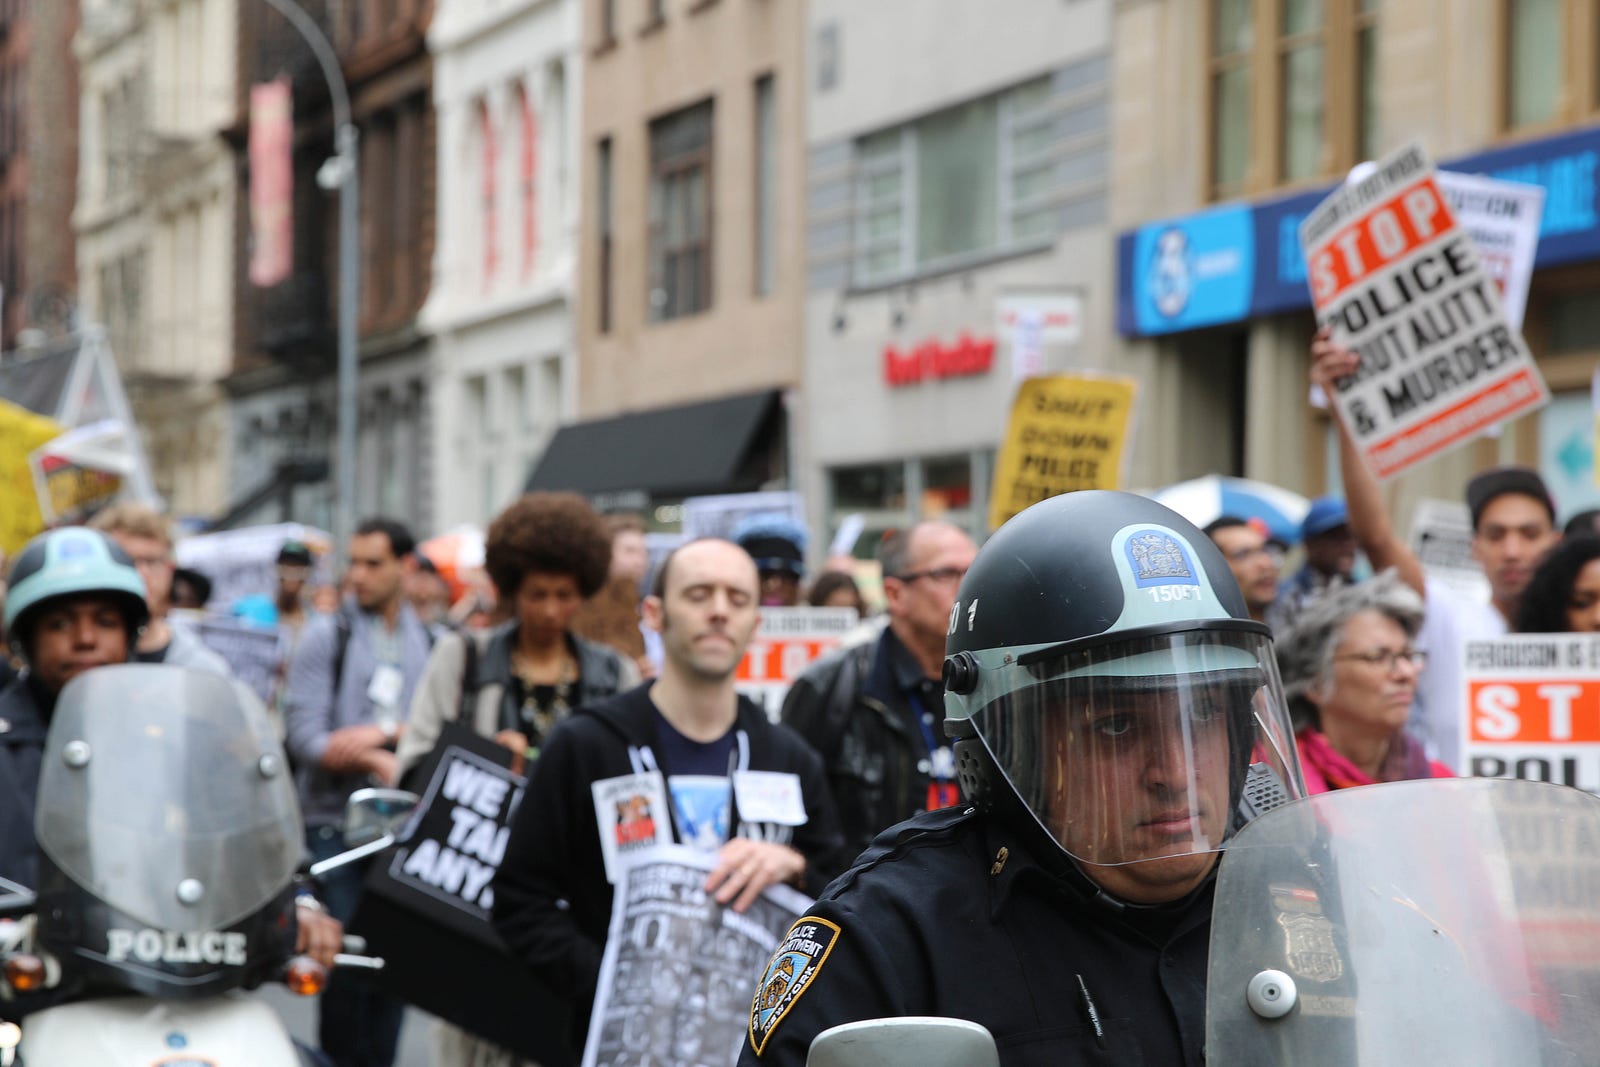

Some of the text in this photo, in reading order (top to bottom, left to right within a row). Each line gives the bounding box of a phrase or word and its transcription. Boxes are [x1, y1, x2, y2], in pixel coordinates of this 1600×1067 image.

[1311, 186, 1439, 299] STOP
[1349, 399, 1377, 437] &
[1381, 324, 1521, 420] MURDER
[1475, 683, 1584, 741] ST
[441, 758, 511, 819] WE
[106, 927, 247, 966] POLICE
[783, 965, 816, 1002] YORK
